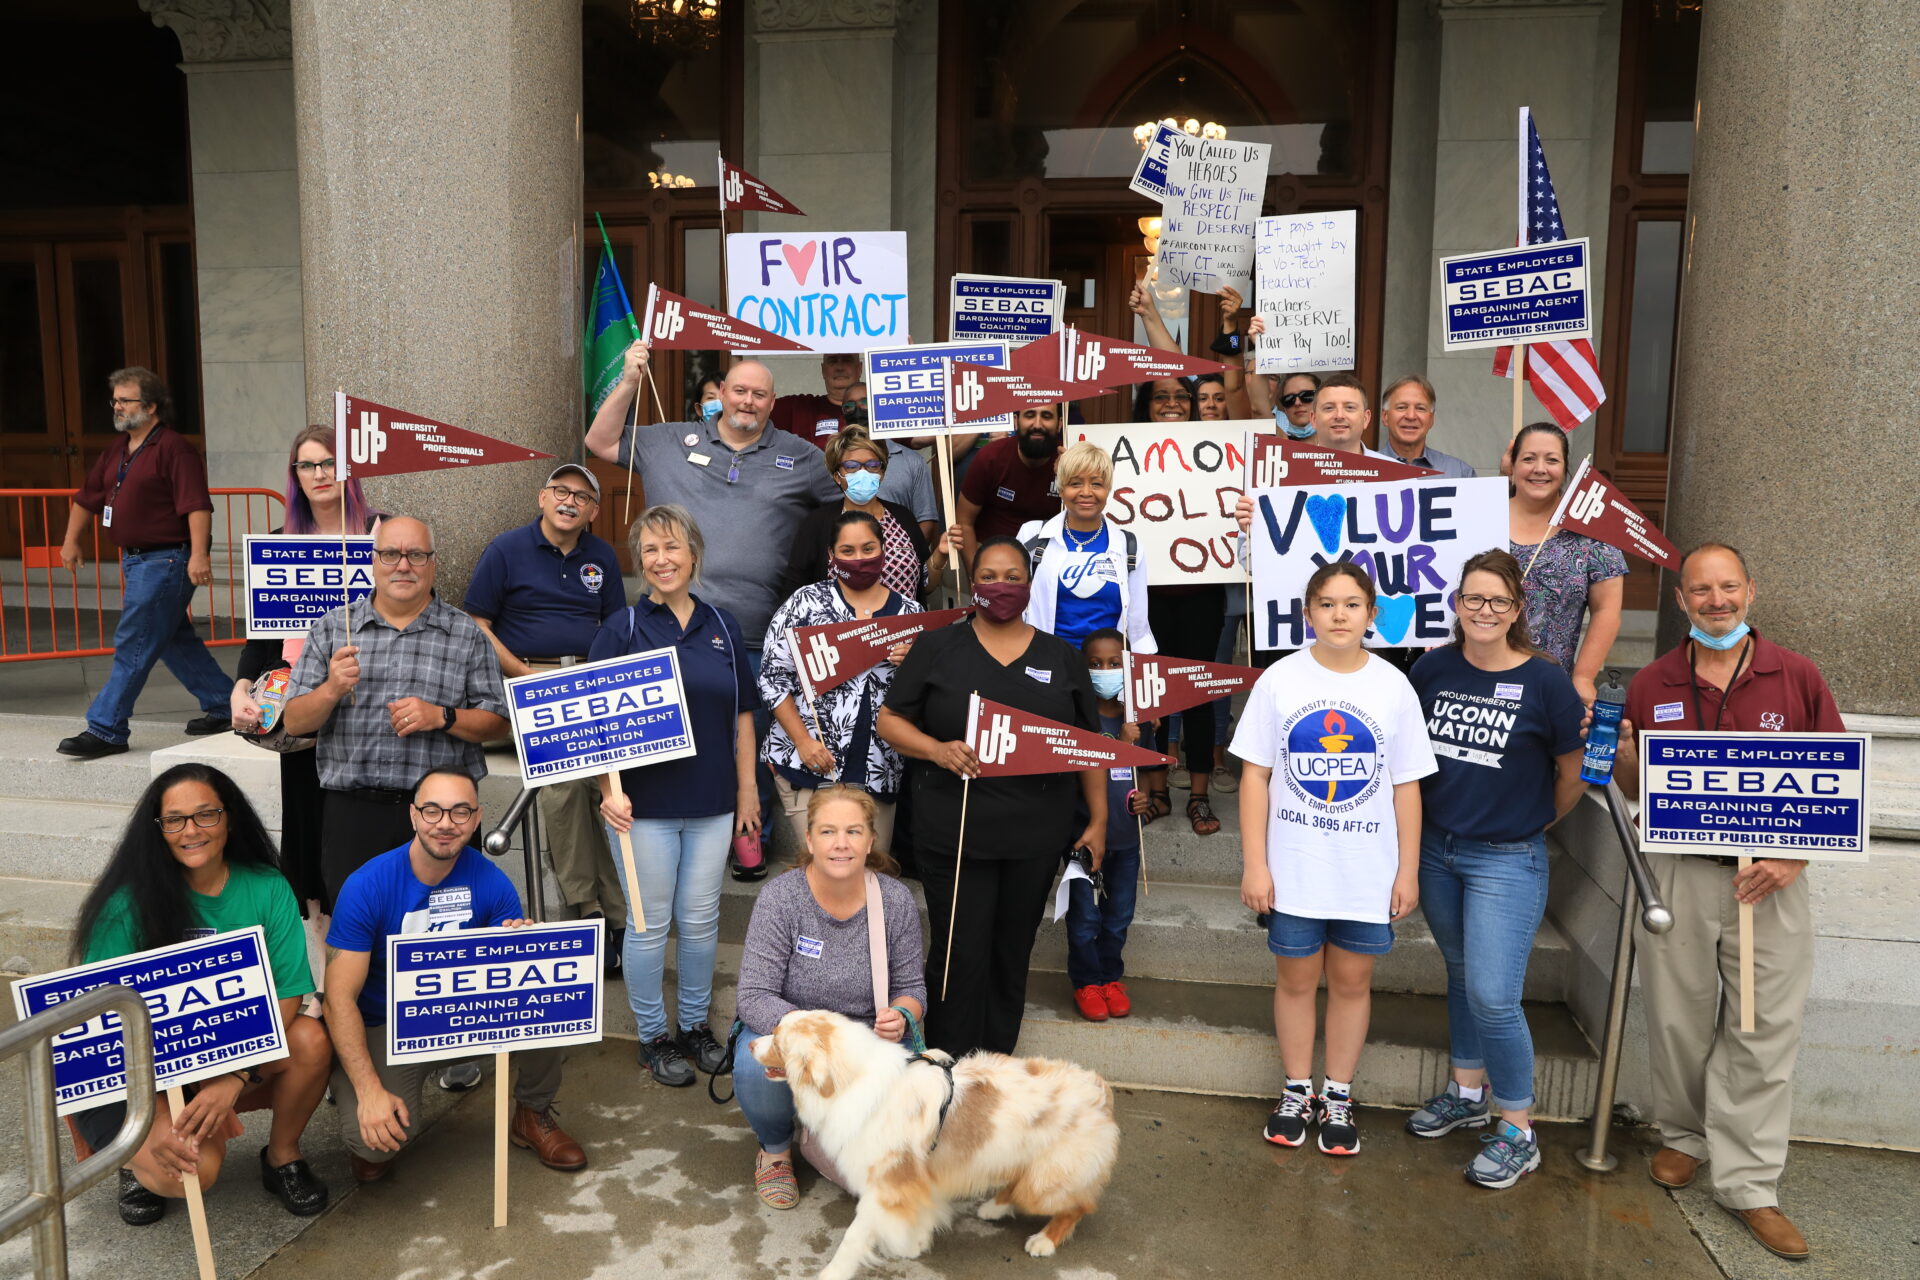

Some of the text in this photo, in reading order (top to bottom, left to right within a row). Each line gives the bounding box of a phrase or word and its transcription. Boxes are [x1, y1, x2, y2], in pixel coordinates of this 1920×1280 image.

[1173, 137, 1259, 162] YOU CALLED US
[1188, 161, 1237, 183] HEROES
[1166, 182, 1257, 203] NOW GIVE US THE
[1183, 201, 1242, 220] RESPECT
[1168, 218, 1256, 239] WE DESERVE!
[1291, 221, 1314, 239] pays
[1322, 217, 1335, 229] to
[1161, 239, 1245, 253] #FAIRCONTRACTS
[1258, 239, 1347, 256] be taught by
[1161, 251, 1212, 270] AFT CT
[1257, 256, 1325, 270] a Vo-Tech
[1456, 255, 1573, 276] STATE EMPLOYEES
[1170, 267, 1216, 290] SVFT
[1459, 272, 1571, 301] SEBAC
[736, 293, 906, 337] CONTRACT
[964, 299, 1044, 312] SEBAC
[1259, 299, 1311, 312] Teachers
[1454, 296, 1578, 316] BARGAINING AGENT
[689, 311, 726, 322] UNIVERSITY
[707, 321, 731, 331] HEALTH
[1275, 310, 1344, 327] DESERVE
[1484, 311, 1549, 324] COALITION
[712, 329, 761, 344] PROFESSIONALS
[1450, 320, 1584, 341] PROTECT PUBLIC SERVICES
[1289, 332, 1312, 353] Pay
[1322, 328, 1350, 348] Too!
[880, 358, 917, 367] STATE
[1260, 357, 1282, 369] AFT
[1288, 357, 1302, 368] CT
[1311, 358, 1329, 366] Local
[391, 422, 438, 433] UNIVERSITY
[876, 419, 919, 430] PROTECT
[416, 433, 445, 443] HEALTH
[423, 444, 484, 456] PROFESSIONALS
[1079, 434, 1244, 475] AMON
[1292, 452, 1335, 460] UNIVERSITY
[1106, 487, 1245, 524] SOLD
[1611, 500, 1644, 524] UNIVERSITY
[1624, 518, 1646, 535] HEALTH
[1169, 531, 1239, 573] OU
[1626, 528, 1668, 559] PROFESSIONALS
[262, 549, 306, 558] STATE
[266, 568, 372, 585] SEBA
[1063, 552, 1096, 590] aft
[259, 593, 349, 602] BARGAINING
[254, 620, 306, 628] PROTECT
[837, 623, 878, 641] UNIVERSITY
[861, 628, 888, 642] HEALTH
[870, 625, 923, 647] PROFESSIONALS
[1168, 665, 1205, 674] UNIVERSITY
[525, 666, 662, 700] STATE EMPLOYEES
[1195, 678, 1243, 688] PROFESSIONALS
[533, 685, 664, 727] SEBAC
[1437, 690, 1522, 710] PROUD MEMBER OF
[1283, 699, 1327, 731] UNIVERSITY
[1340, 701, 1384, 745] CONNECTICUT
[1433, 700, 1517, 731] UCONN
[530, 711, 674, 746] BARGAINING AGENT
[1022, 725, 1069, 737] UNIVERSITY
[1426, 718, 1509, 748] NATION
[1760, 721, 1781, 731] NCTM
[567, 730, 644, 752] COALITION
[1046, 737, 1077, 746] HEALTH
[530, 736, 686, 776] PROTECT PUBLIC SERVICES
[1052, 747, 1116, 760] PROFESSIONALS
[1662, 747, 1845, 761] STATE EMPLOYEES
[1298, 758, 1367, 776] UCPEA
[1666, 770, 1840, 795] SEBAC
[1308, 798, 1354, 814] EMPLOYEES
[1656, 799, 1849, 814] BARGAINING AGENT
[1277, 808, 1380, 833] LOCAL 3695 AFT-CT
[1701, 814, 1801, 827] COALITION
[1650, 830, 1857, 848] PROTECT PUBLIC SERVICES
[430, 893, 470, 903] SEBAC
[411, 939, 582, 962] STATE EMPLOYEES
[120, 951, 243, 987] EMPLOYEES
[415, 961, 577, 997] SEBAC
[405, 991, 586, 1017] BARGAINING AGENT
[192, 1005, 259, 1030] AGENT
[450, 1009, 544, 1027] COALITION
[397, 1020, 592, 1051] PROTECT PUBLIC SERVICES
[198, 1036, 275, 1065] SERVICES
